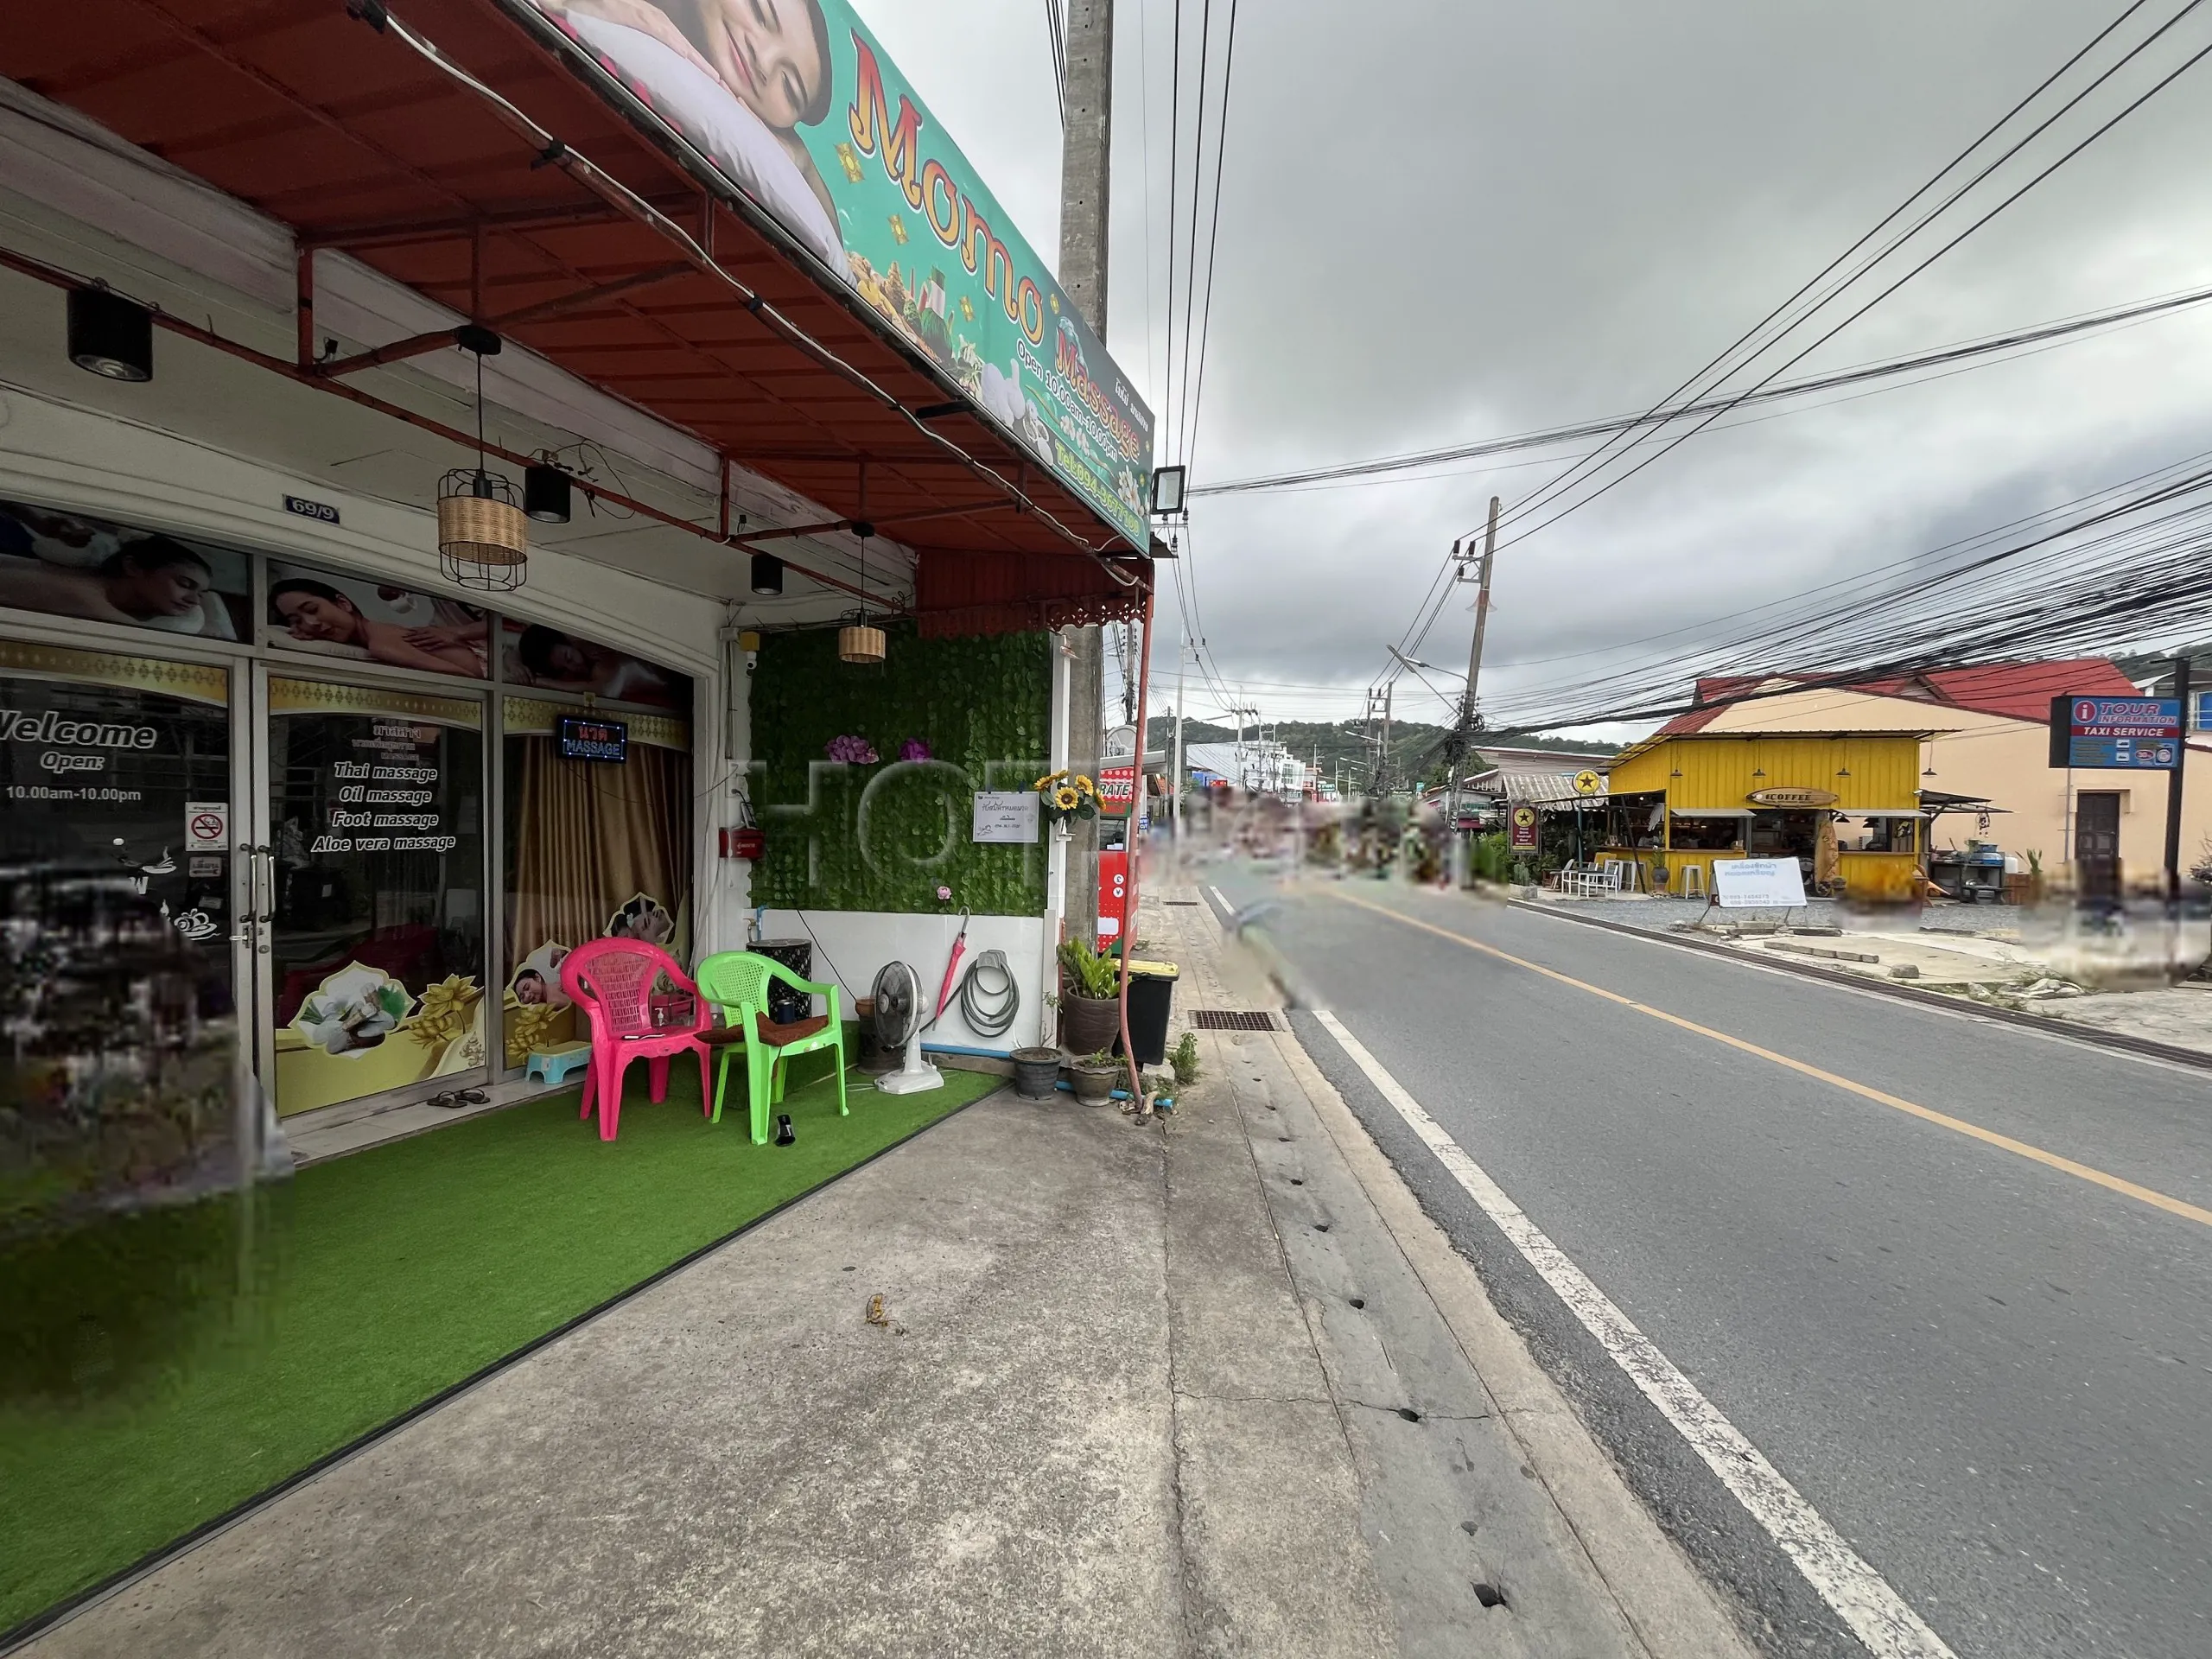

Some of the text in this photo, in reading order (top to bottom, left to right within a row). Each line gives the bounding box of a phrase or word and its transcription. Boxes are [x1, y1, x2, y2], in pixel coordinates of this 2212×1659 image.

[848, 27, 1045, 346] Momo
[1017, 338, 1044, 380] Open
[1055, 325, 1141, 465] Massage
[292, 500, 334, 519] 69/9
[2099, 702, 2161, 715] TOUR
[2097, 715, 2177, 725] INFORMATION
[578, 726, 608, 741] นวด
[2083, 727, 2165, 736] TAXI SERVICE
[566, 739, 620, 755] MASSAGE
[40, 751, 105, 774] Open:
[334, 761, 438, 783] Thai massage
[6, 785, 142, 803] 10.00am-10.00pm
[339, 785, 433, 806] Oil massage
[332, 810, 439, 830] Foot massage
[310, 836, 456, 853] Aloe vera massage
